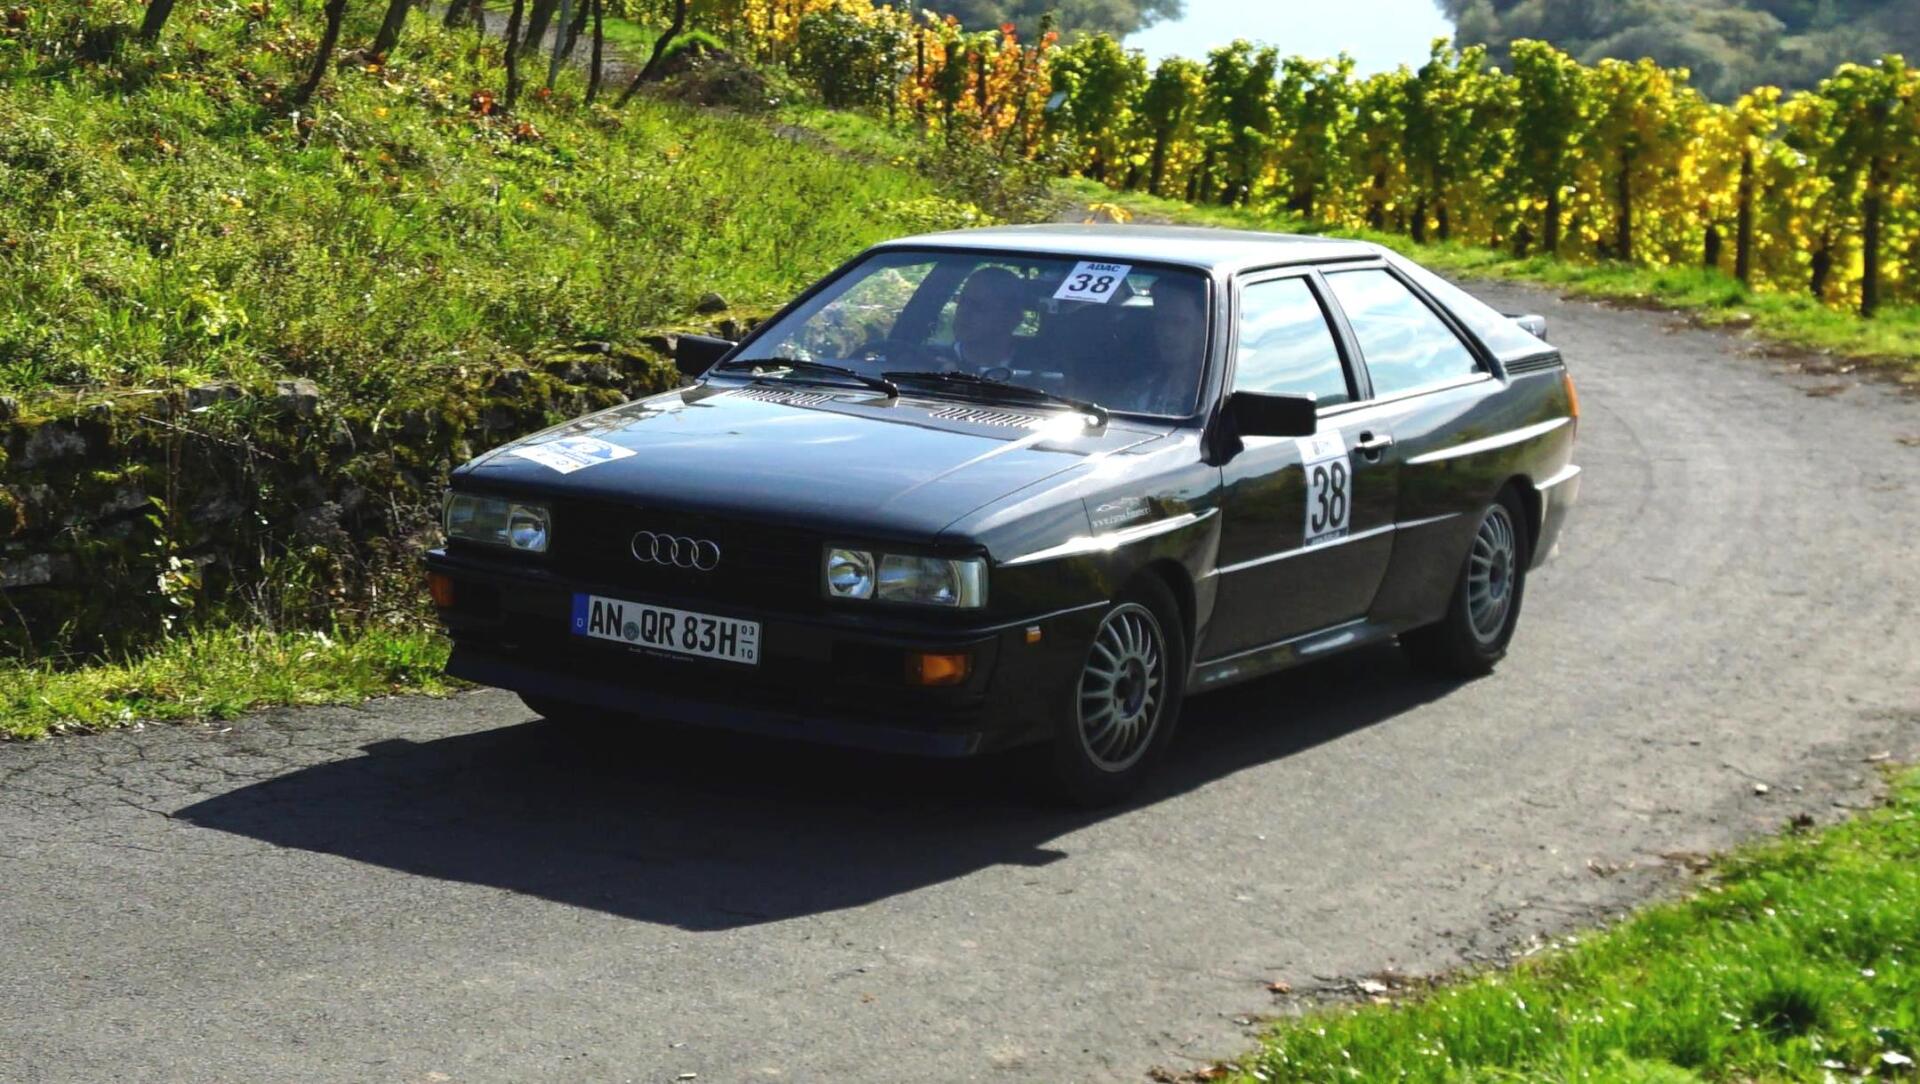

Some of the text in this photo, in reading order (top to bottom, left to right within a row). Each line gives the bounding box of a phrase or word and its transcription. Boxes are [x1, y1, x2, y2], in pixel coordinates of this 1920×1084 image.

[1087, 263, 1121, 272] ADAC
[1068, 273, 1116, 294] 38
[1311, 461, 1346, 534] 38
[589, 600, 624, 637] AN
[641, 609, 676, 647] QR
[682, 616, 738, 657] 83H
[741, 625, 755, 636] 03
[740, 648, 754, 660] 10
